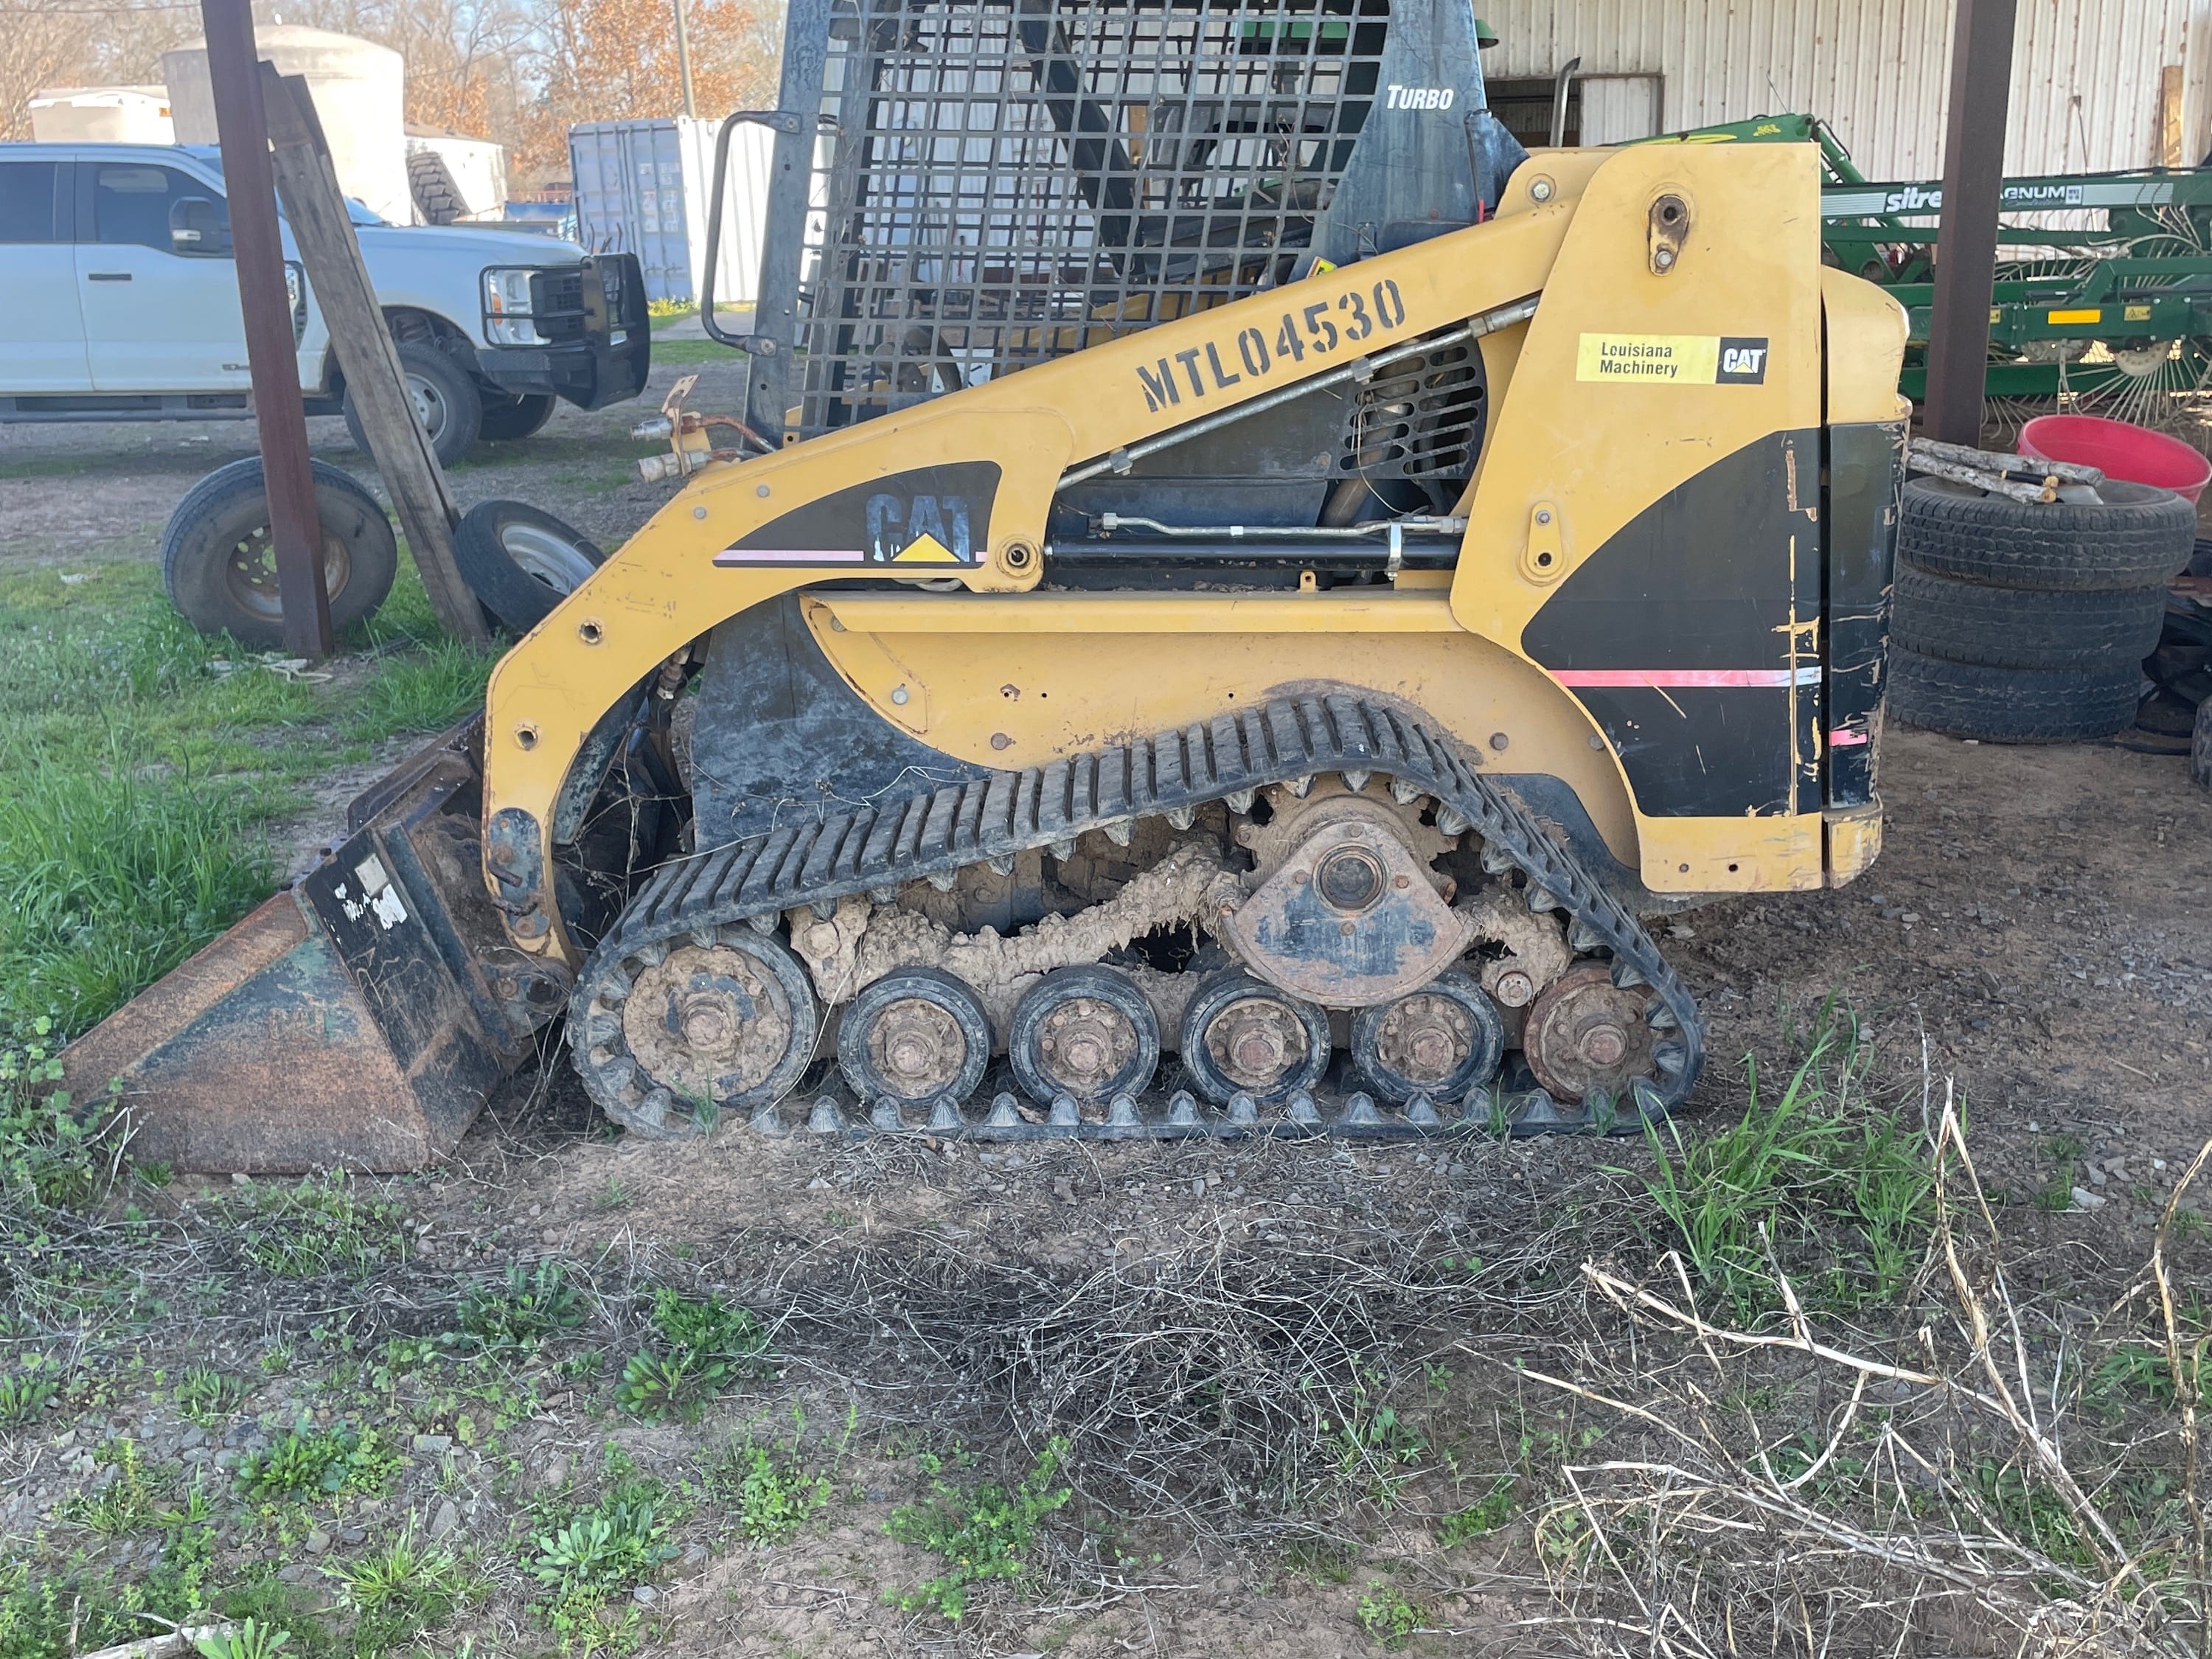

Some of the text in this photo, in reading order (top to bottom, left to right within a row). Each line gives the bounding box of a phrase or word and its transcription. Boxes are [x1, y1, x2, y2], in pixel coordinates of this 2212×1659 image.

[1387, 85, 1454, 110] TURBO
[1886, 187, 1943, 212] sitre
[1999, 186, 2065, 199] GNUM
[1135, 279, 1405, 413] MTL04530
[1601, 342, 1673, 358] Louisiana
[1599, 359, 1678, 378] Machinery
[1722, 348, 1765, 374] CAT
[866, 493, 976, 563] CAT
